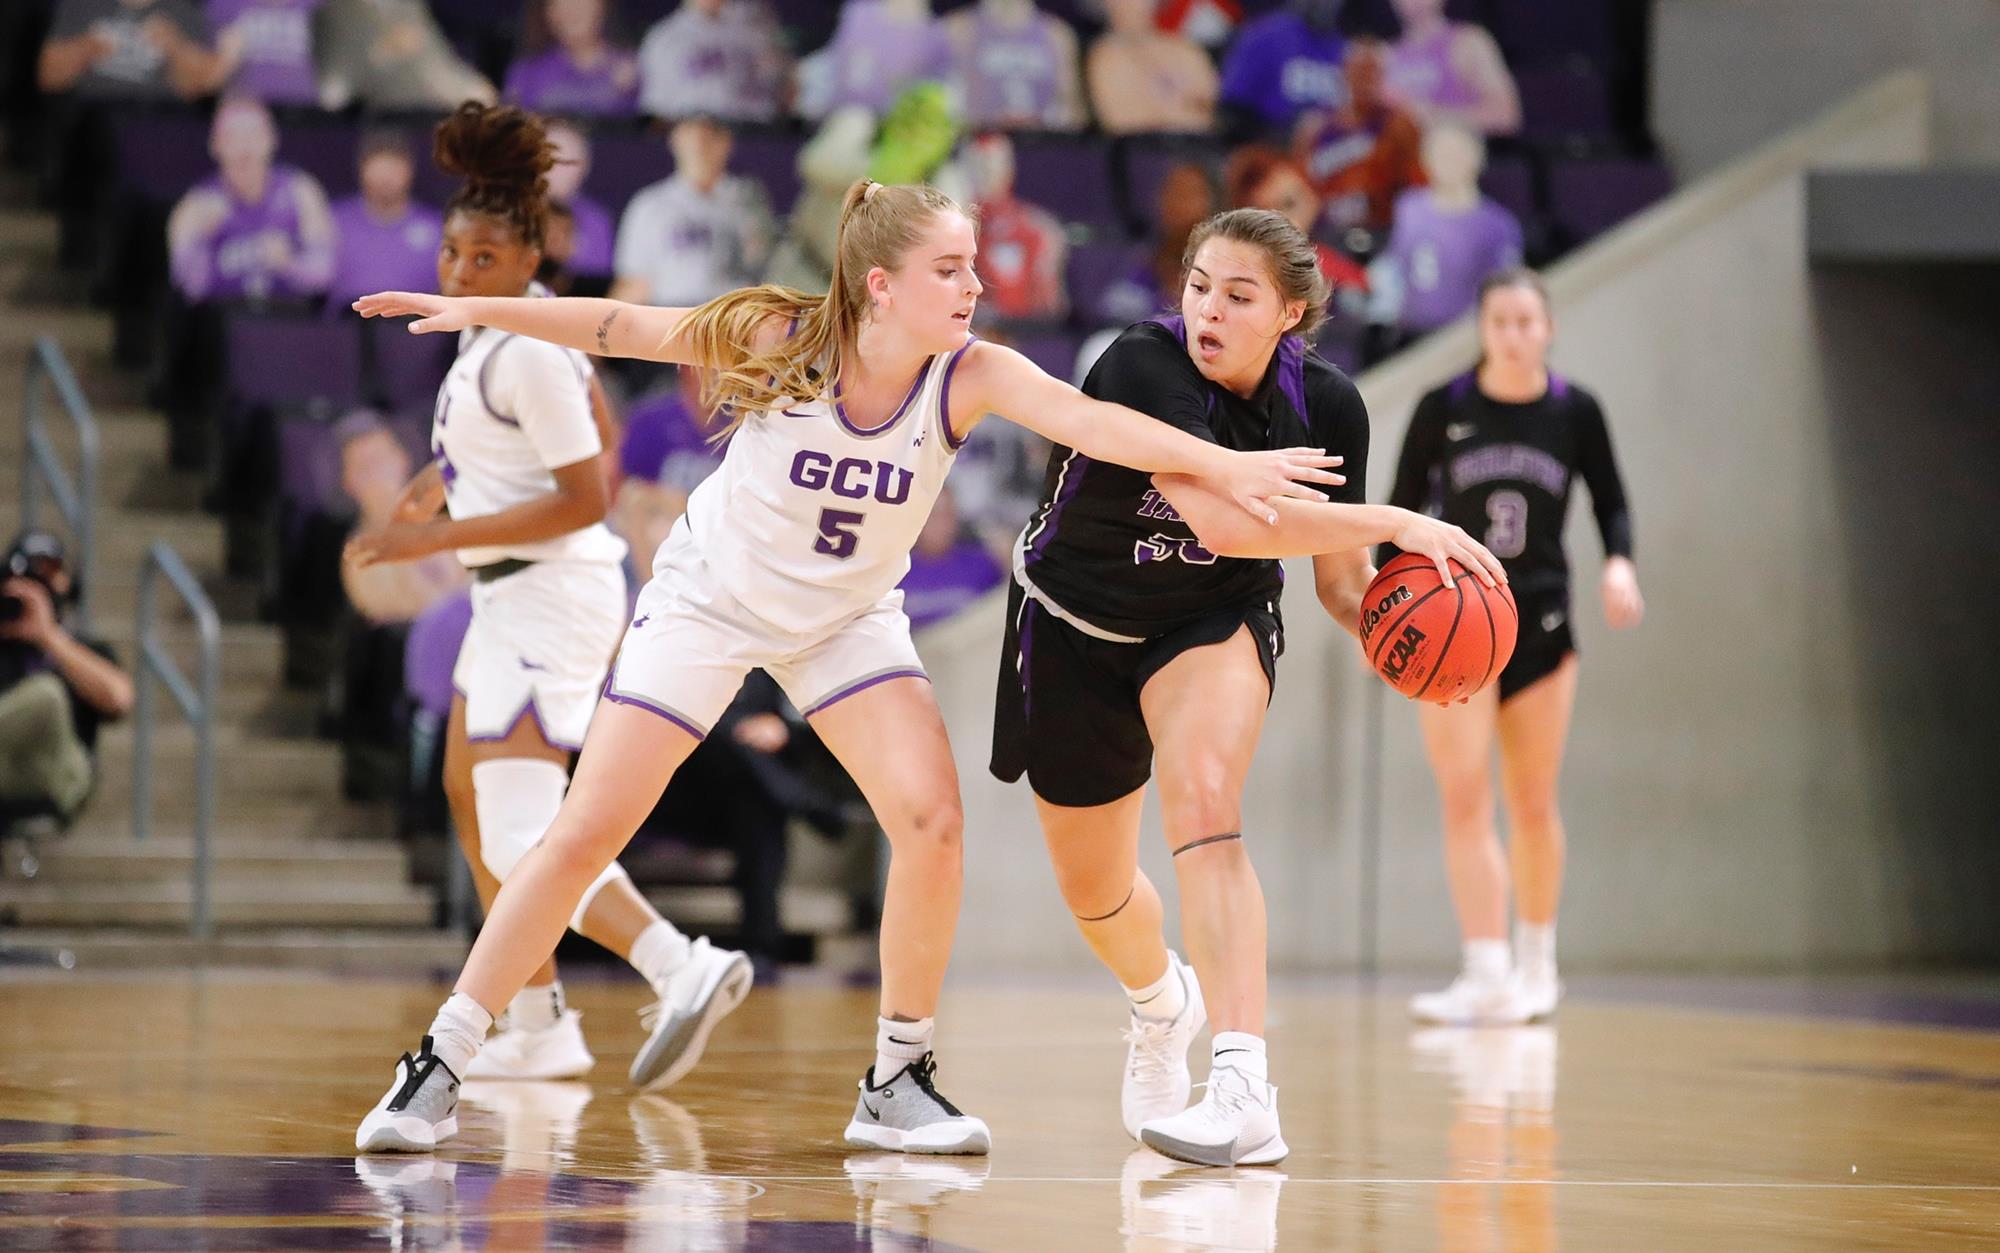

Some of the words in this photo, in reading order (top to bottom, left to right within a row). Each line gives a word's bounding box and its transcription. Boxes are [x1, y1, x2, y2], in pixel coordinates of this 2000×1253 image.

[789, 449, 914, 505] GCU
[811, 506, 867, 561] 5
[1485, 488, 1528, 559] 3
[1360, 584, 1413, 652] ilson
[1381, 624, 1427, 685] NCAA
